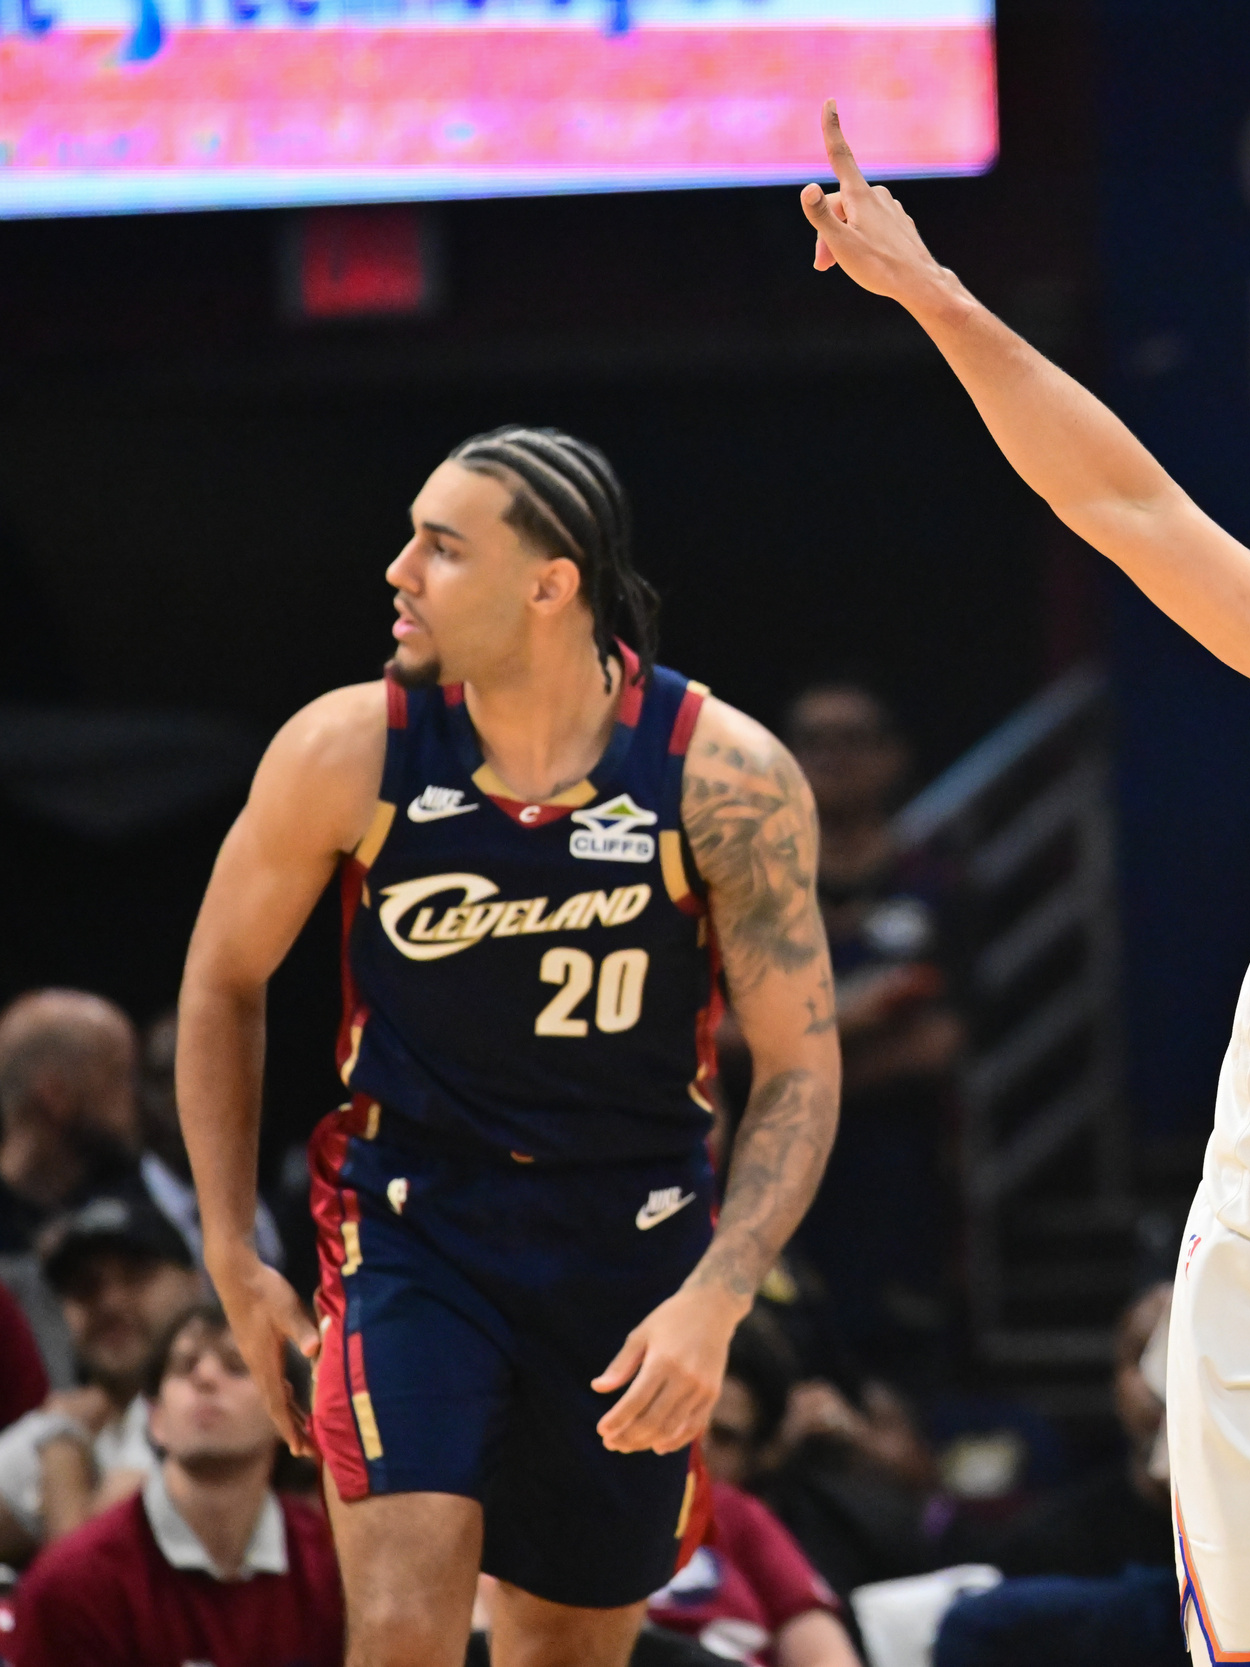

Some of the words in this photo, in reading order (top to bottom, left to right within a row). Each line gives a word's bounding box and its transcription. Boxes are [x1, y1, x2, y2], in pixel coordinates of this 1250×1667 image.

[574, 836, 649, 857] CLIFFS
[379, 872, 651, 961] CLEVELAND
[534, 946, 649, 1037] 20
